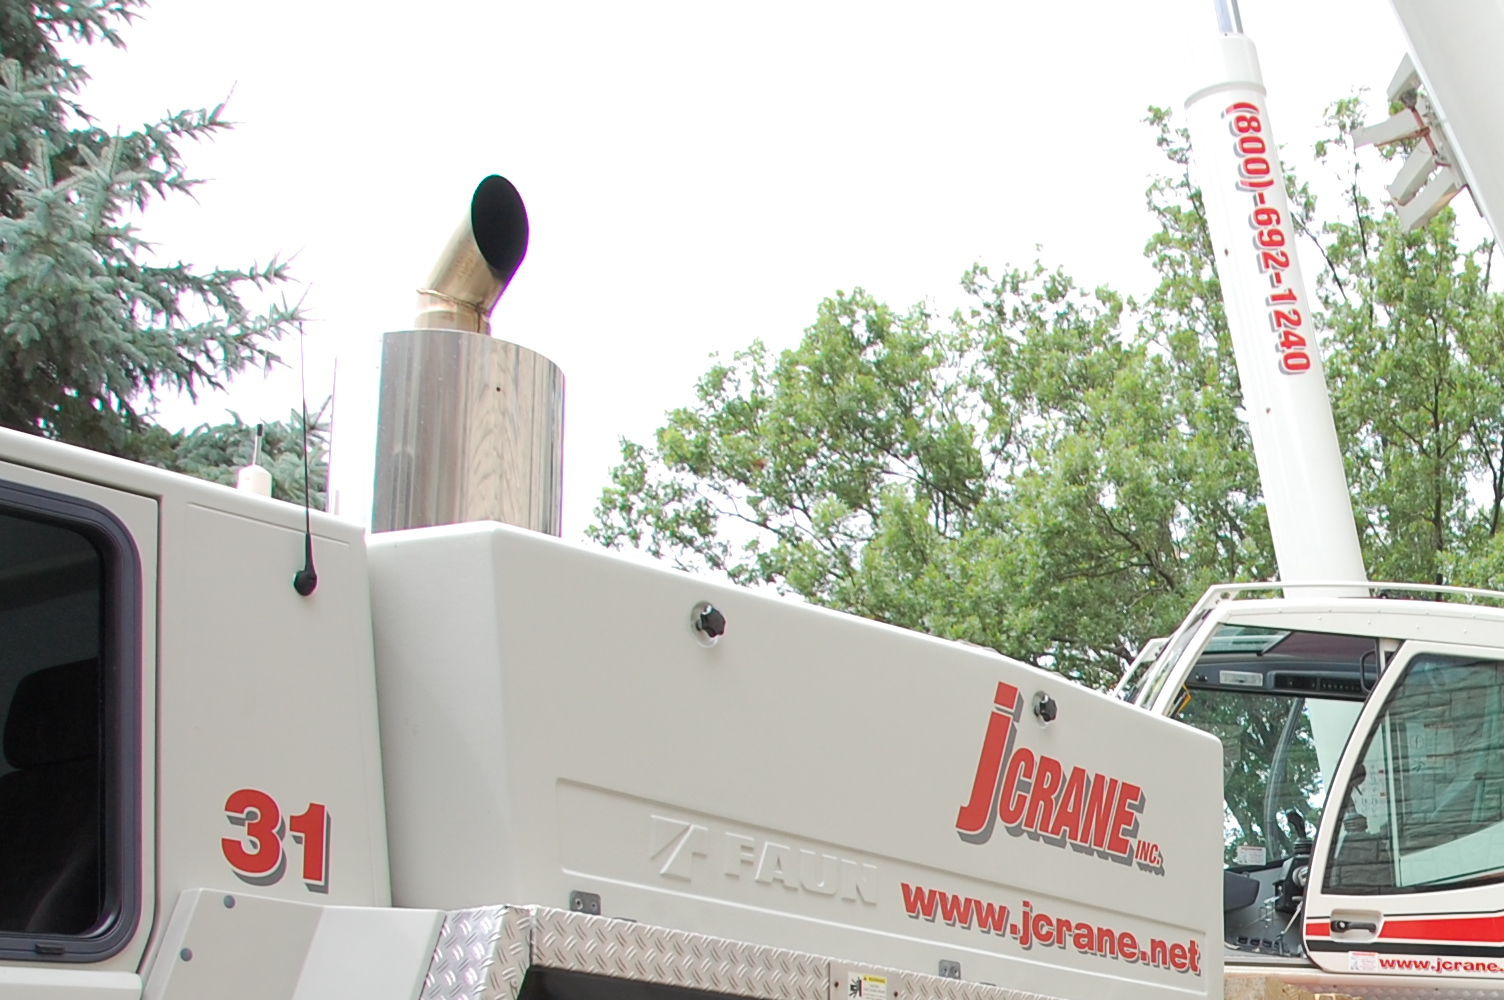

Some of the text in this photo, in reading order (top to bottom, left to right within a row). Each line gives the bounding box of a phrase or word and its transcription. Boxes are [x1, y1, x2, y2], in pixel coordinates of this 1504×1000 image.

[1223, 101, 1312, 373] (800)-692-1240
[221, 788, 331, 892] 31
[724, 831, 877, 906] FAUN
[901, 882, 1201, 975] www.jcrane.net
